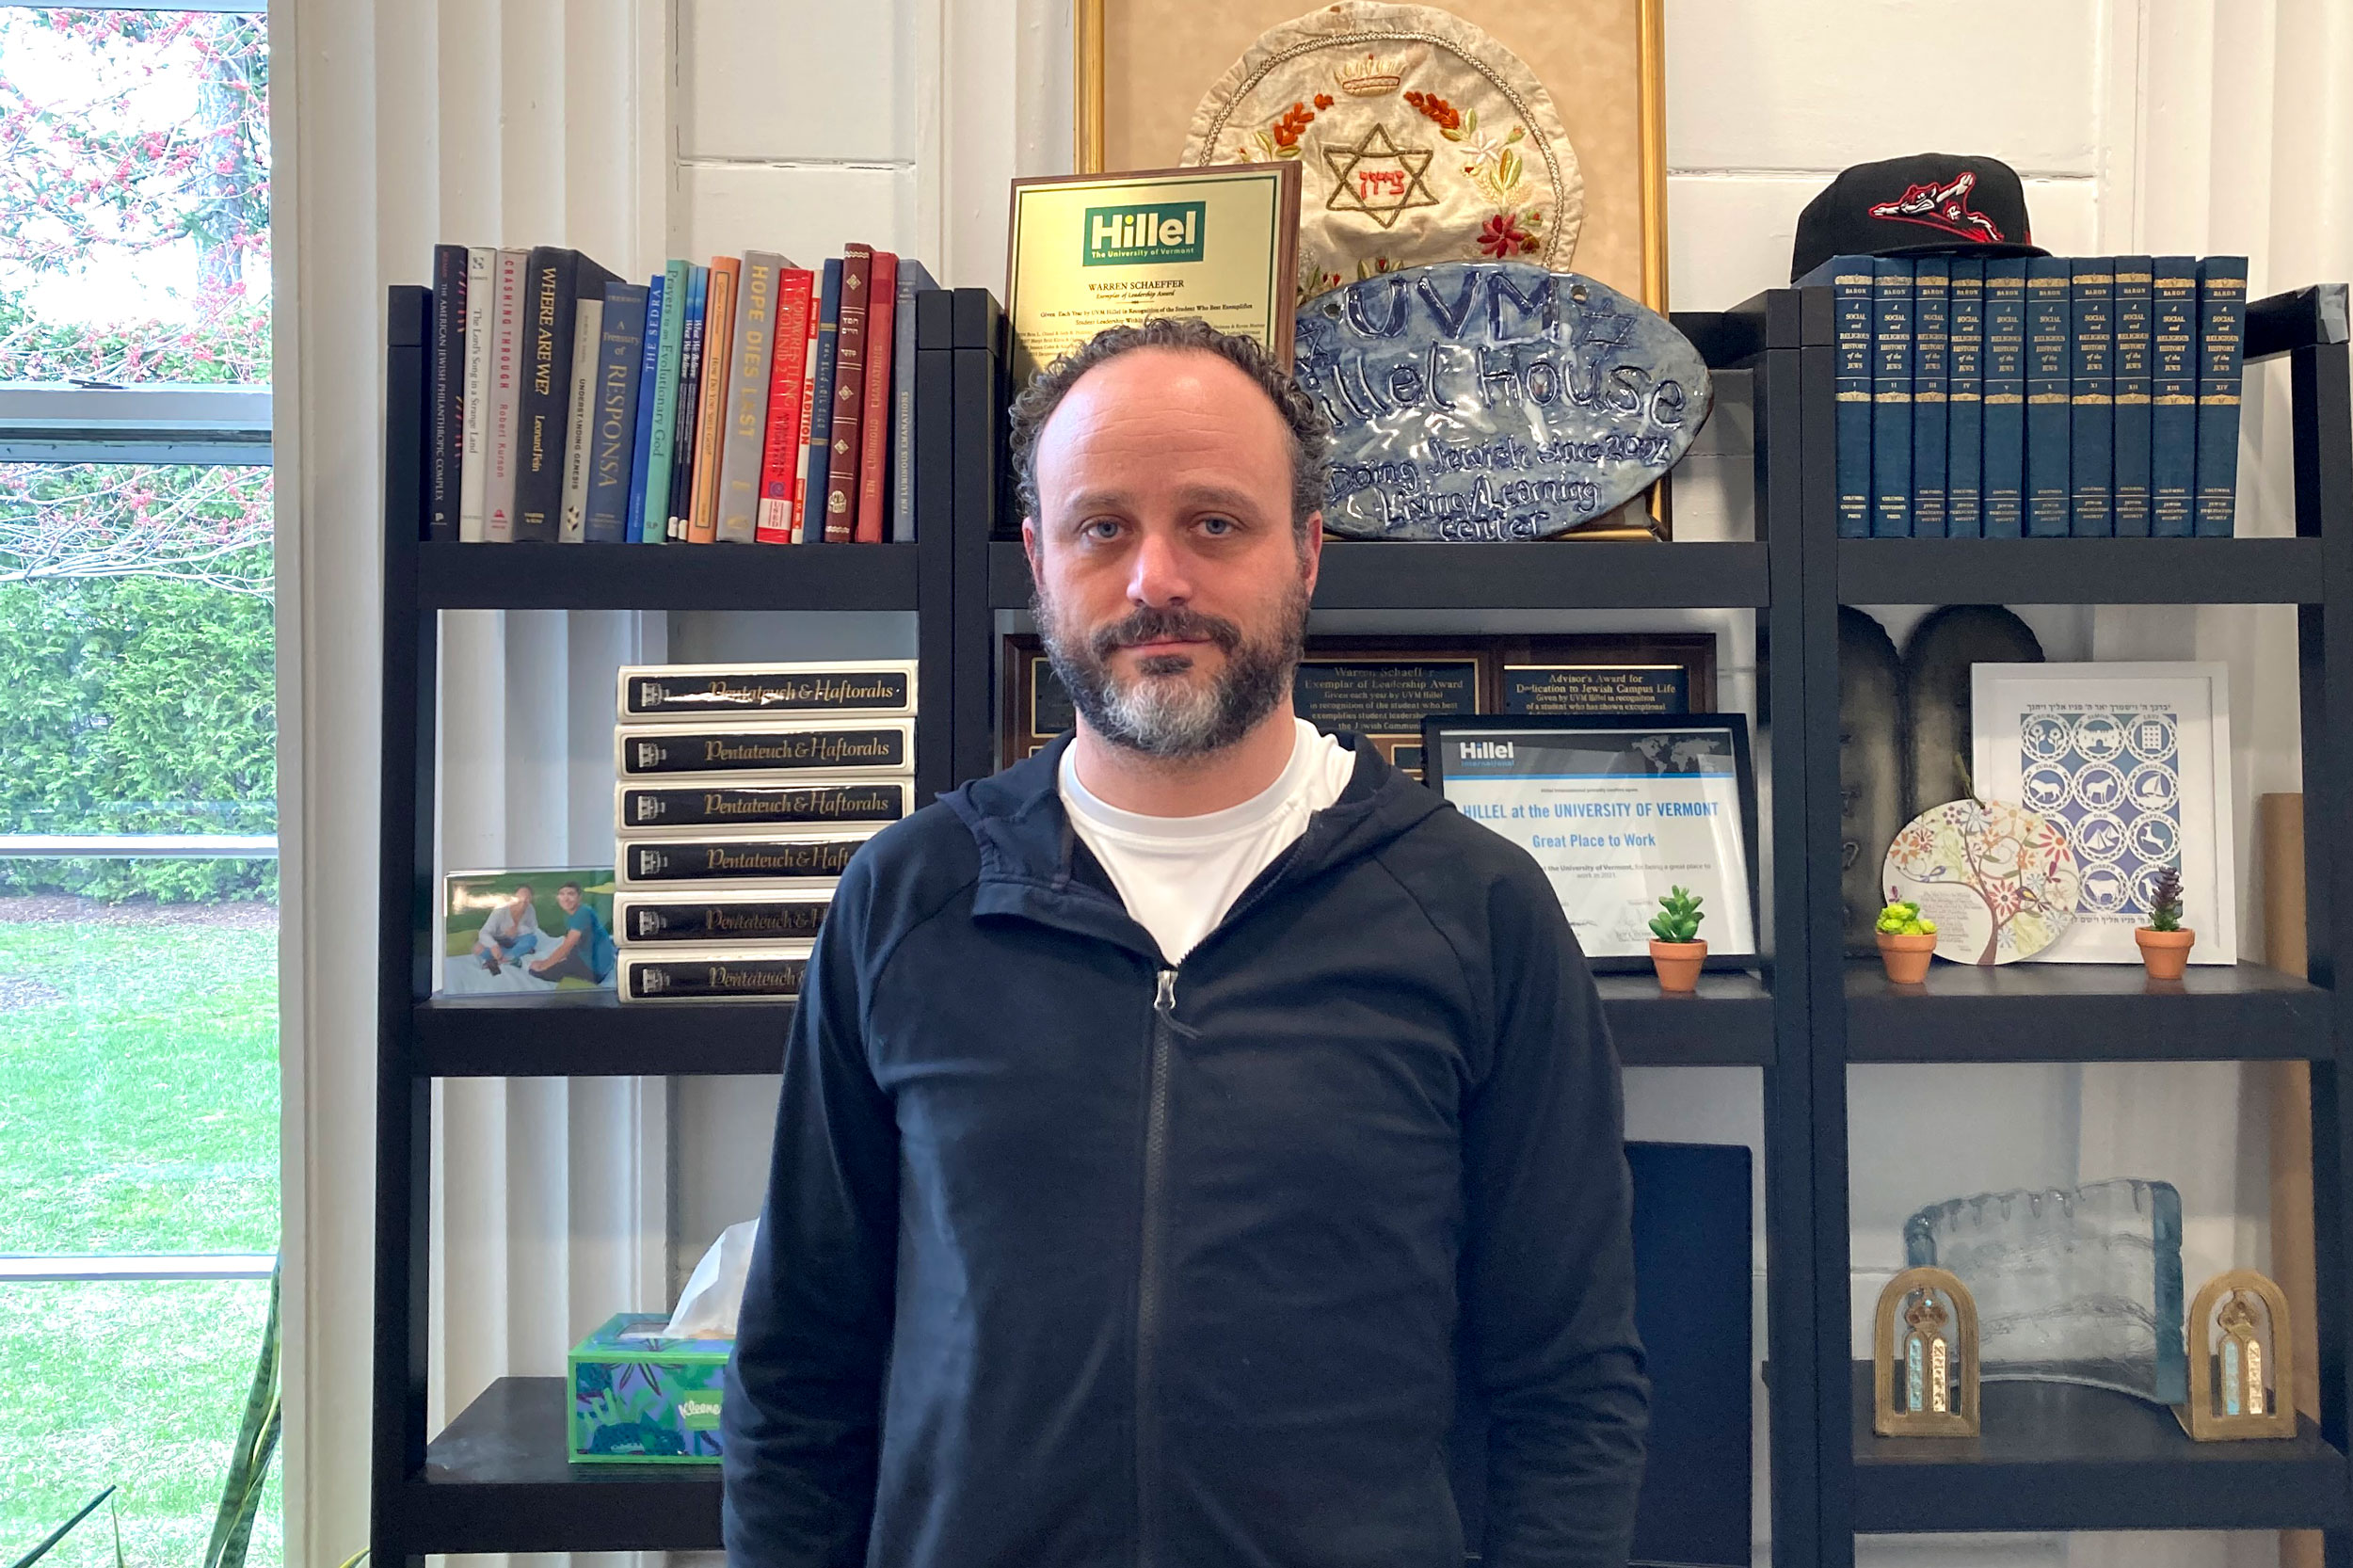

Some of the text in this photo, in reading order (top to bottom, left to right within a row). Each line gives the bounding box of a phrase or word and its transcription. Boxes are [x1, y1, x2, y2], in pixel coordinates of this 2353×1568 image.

[1092, 211, 1196, 249] Hillel
[1108, 249, 1148, 258] University
[539, 267, 556, 326] WHERE
[664, 270, 679, 314] Prayers
[1088, 280, 1184, 291] WARREN SCHAEFFER
[1128, 290, 1157, 299] Leadership
[472, 309, 483, 326] The
[1343, 270, 1561, 340] UVM
[438, 299, 448, 346] AMERICAN
[500, 260, 514, 389] CRASHING THROUGH
[646, 290, 661, 372] THE SEDRA
[536, 328, 552, 361] ARE
[614, 346, 626, 356] of
[738, 265, 769, 437] HOPE DIES LAST
[438, 349, 447, 381] JEWISH
[470, 357, 481, 378] Song
[471, 380, 478, 389] in
[654, 345, 673, 425] Evolutionary
[436, 383, 446, 456] PHILANTHROPIC
[498, 404, 508, 438] Robert
[800, 377, 814, 445] TRADITION
[901, 391, 909, 450] EMANATIONS
[533, 415, 545, 453] Leonard
[571, 378, 586, 489] UNDERSTANDING GENESIS
[599, 364, 628, 488] RESPONSA
[652, 429, 665, 456] God
[1426, 434, 1532, 473] Jewish
[435, 459, 444, 501] COMPLEX
[798, 683, 813, 699] &
[814, 679, 894, 703] Haftorahs
[1357, 680, 1368, 688] of
[1371, 680, 1427, 690] Leadership
[1431, 680, 1464, 689] Award
[1516, 684, 1676, 695] Dedication to Jewish Campus Life
[1549, 674, 1643, 683] Advisor's Award for
[704, 737, 890, 761] Pentateuch & Haftorahs
[1460, 741, 1514, 759] Hillel
[704, 792, 889, 815] Pentateuch & Haftorahs
[1463, 801, 1720, 819] HILLEL at the UNIVERSITY OF VERMONT
[1532, 833, 1657, 848] Great Place to Work
[707, 848, 793, 870] Pentateuch
[795, 852, 810, 867] &
[706, 908, 793, 930] Pentateuch
[795, 911, 809, 928] &
[708, 967, 795, 987] Pentateuch
[679, 1400, 722, 1419] Kleene
